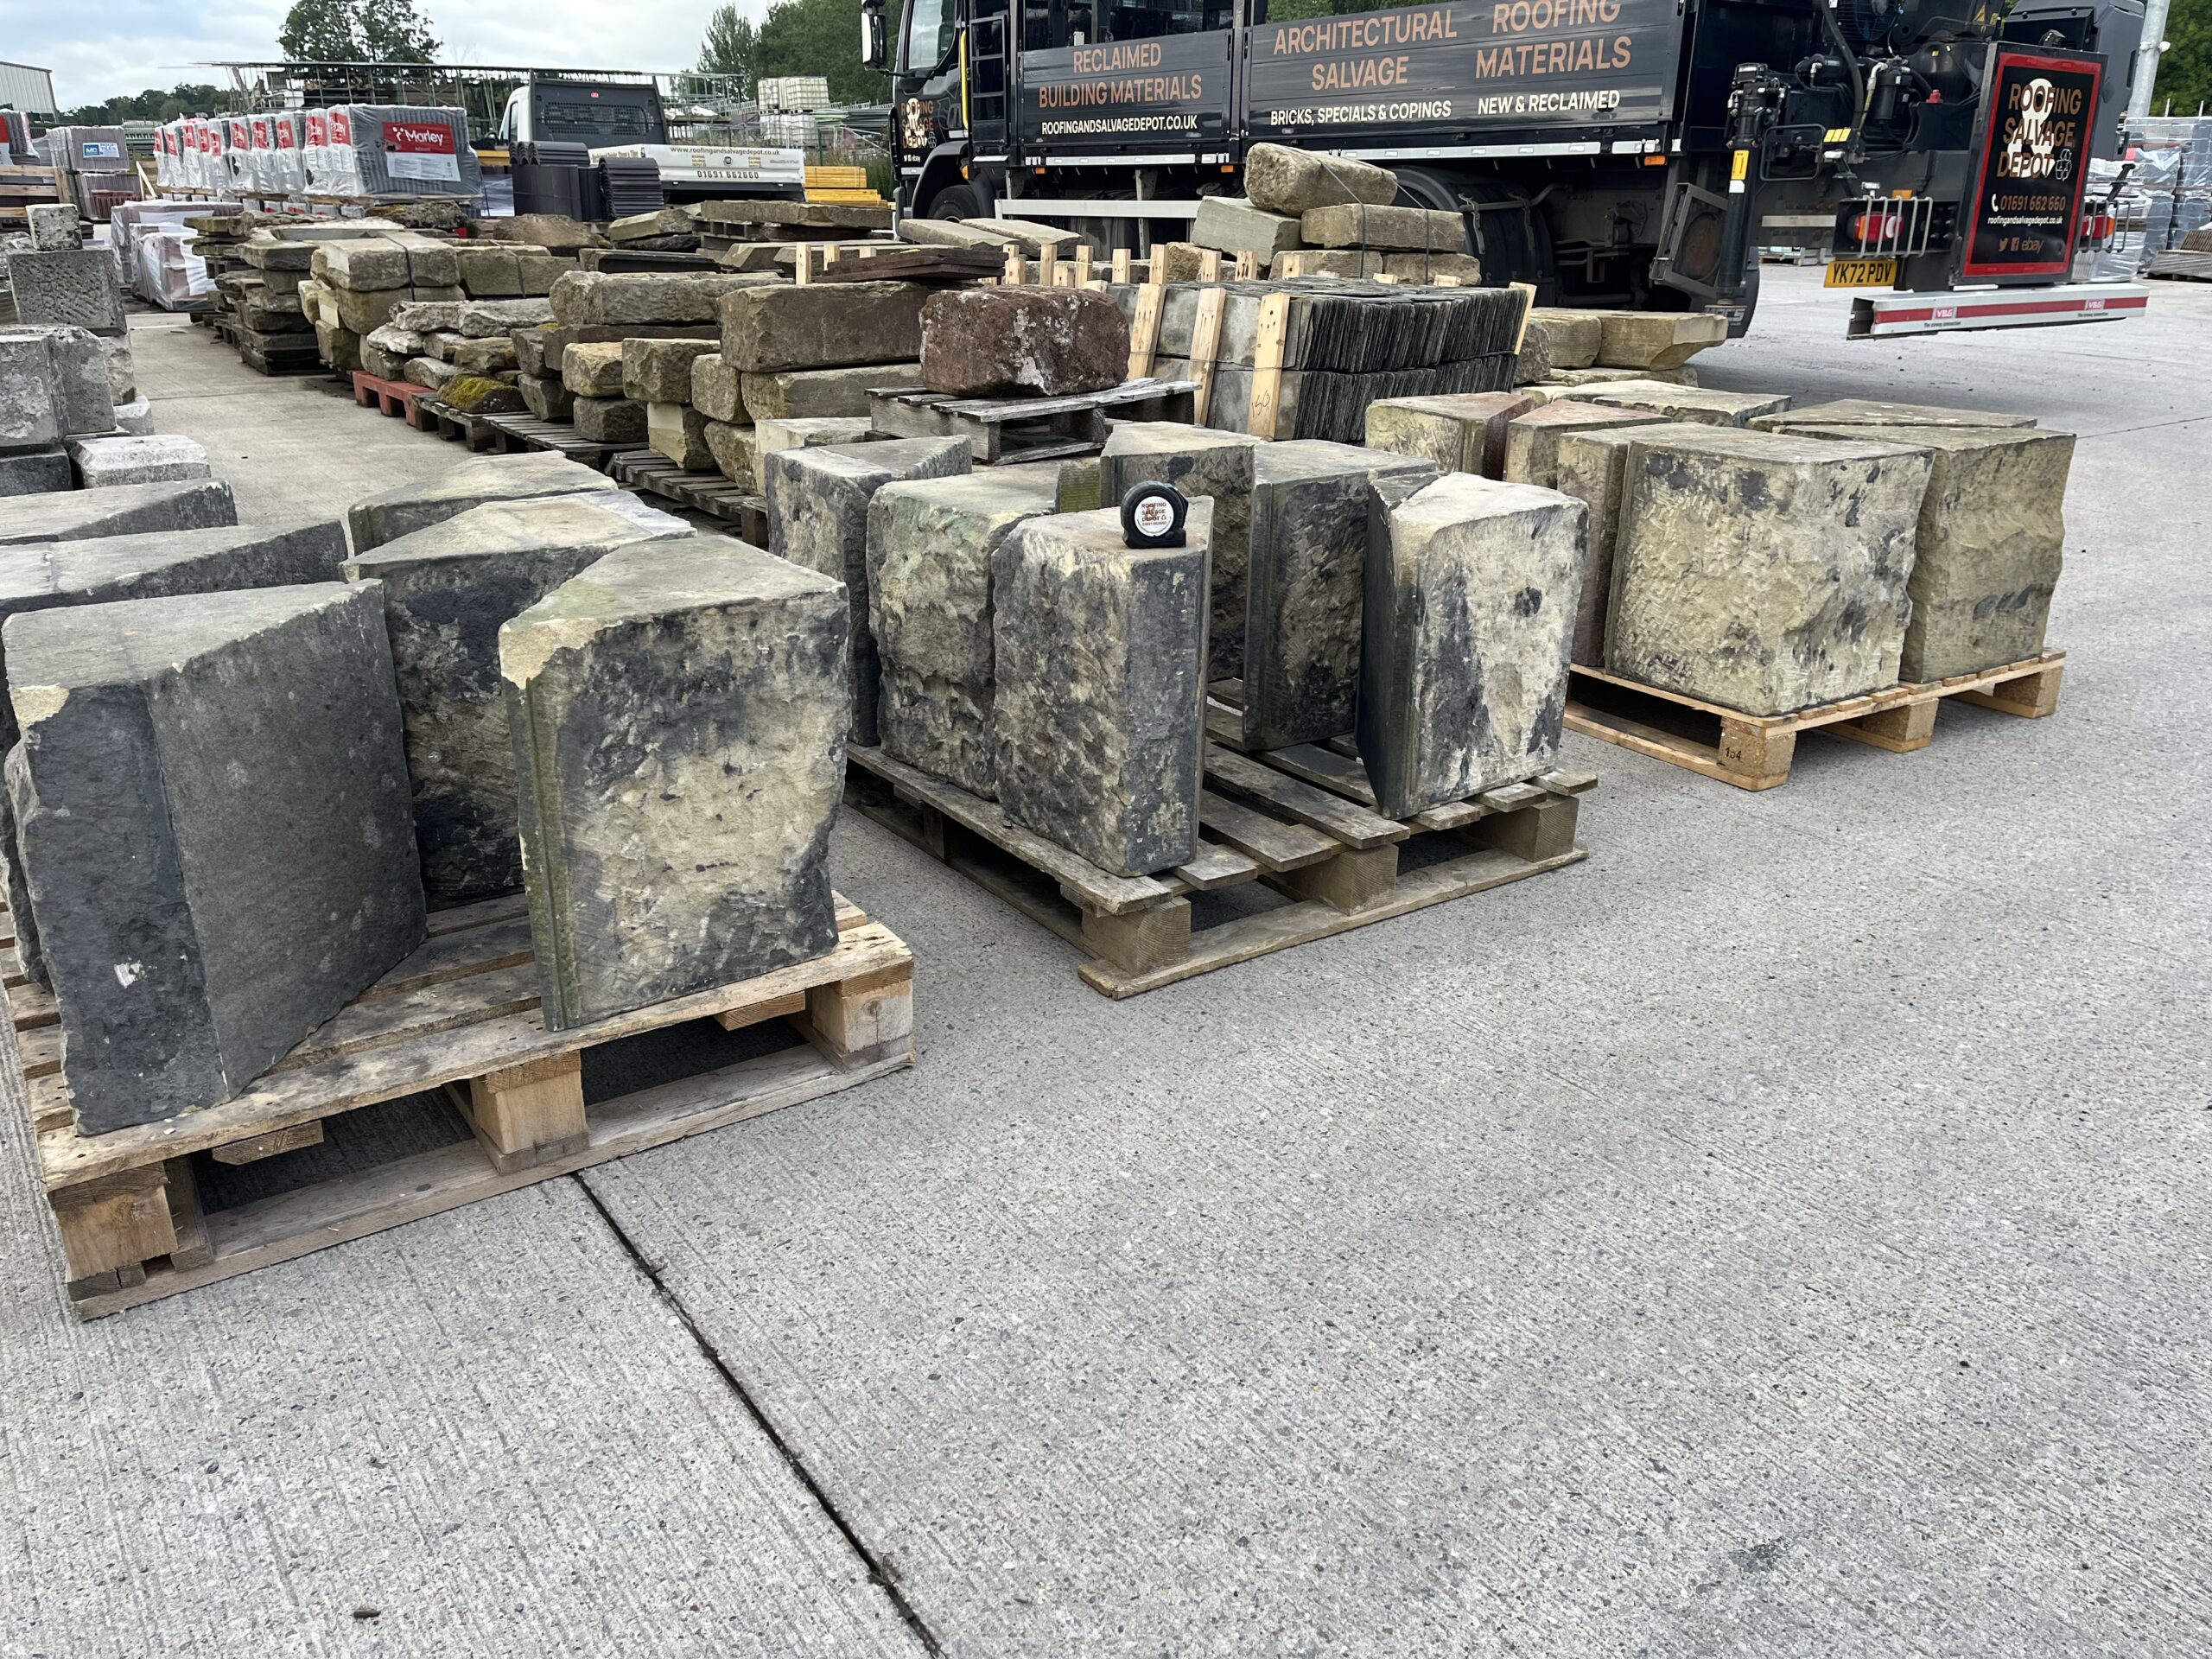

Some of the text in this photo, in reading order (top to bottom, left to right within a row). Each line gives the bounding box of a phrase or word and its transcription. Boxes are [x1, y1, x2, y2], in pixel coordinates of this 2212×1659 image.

[1492, 0, 1621, 34] ROOFING
[1274, 10, 1458, 55] ARCHITECTURAL
[1073, 42, 1162, 73] RECLAIMED
[1475, 35, 1632, 79] MATERIALS
[1312, 55, 1409, 91] SALVAGE
[1039, 74, 1203, 109] BUILDING MATERIALS
[1478, 90, 1621, 115] NEW & RECLAIMED
[2008, 83, 2082, 116] ROOFING
[900, 100, 934, 116] ROOFING
[1270, 100, 1452, 126] BRICKS, SPECIALS & COPINGS
[901, 118, 934, 132] SALVAGE
[1042, 114, 1198, 135] ROOFINGANDSALVAGEDEPOT.CO.UK
[2002, 117, 2076, 148] SALVAGE
[404, 129, 443, 146] Marley
[902, 134, 928, 149] DEPOT
[1997, 151, 2055, 179] DEPOT
[2000, 195, 2067, 211] 01691 662 660
[1987, 215, 2063, 226] roofingandsalvagedepot.co.uk
[2022, 237, 2044, 253] ebay
[1833, 263, 1892, 283] YK72 PDV
